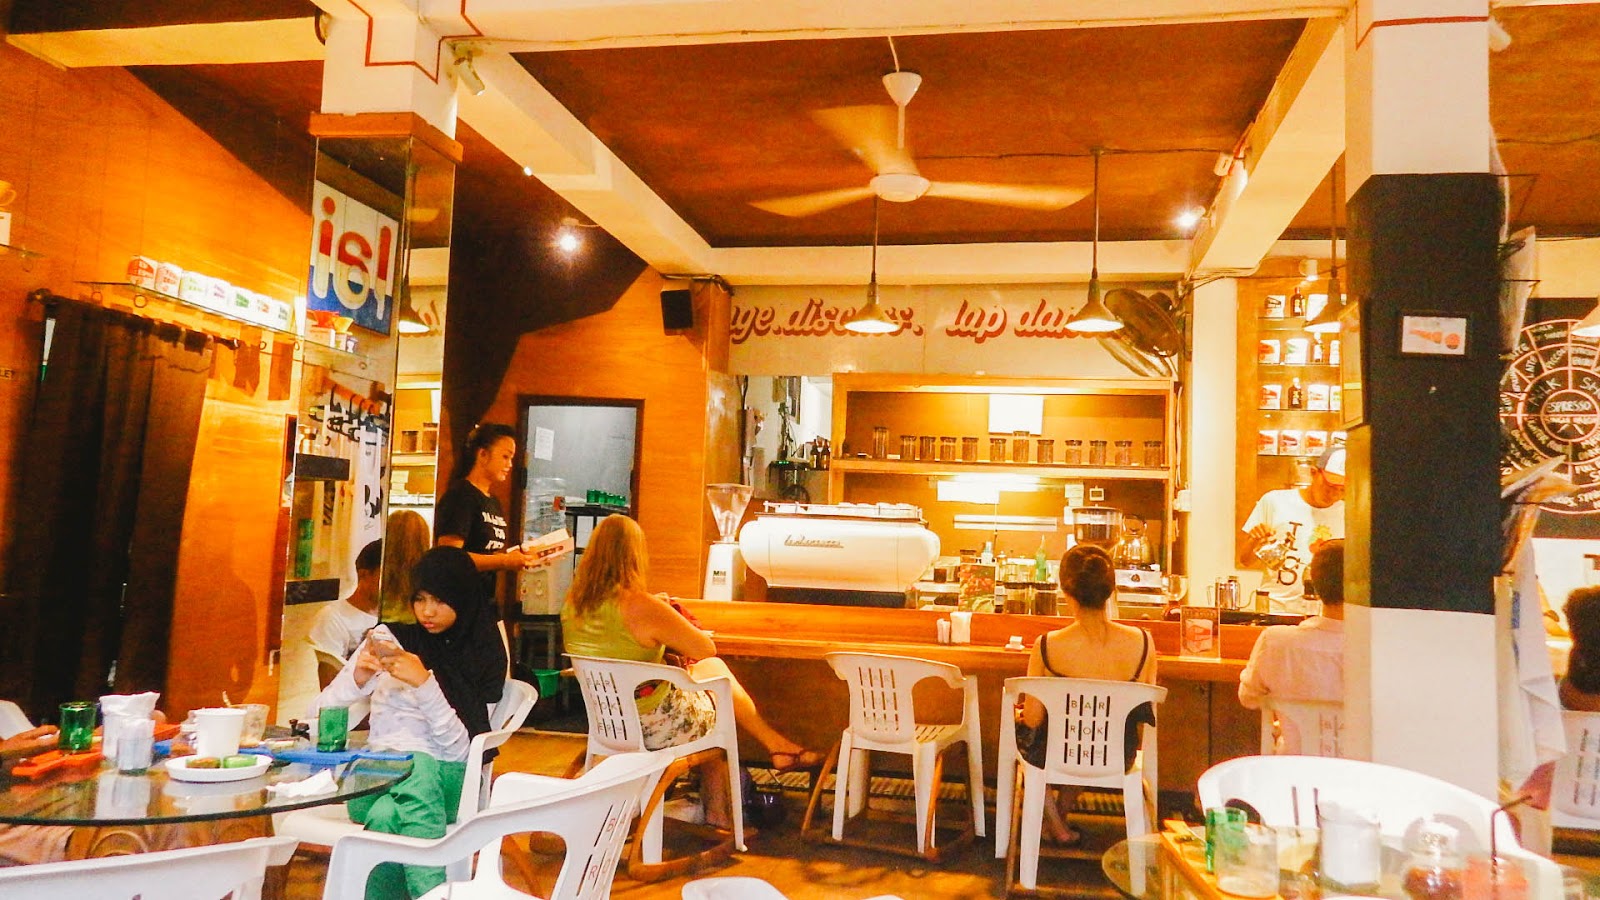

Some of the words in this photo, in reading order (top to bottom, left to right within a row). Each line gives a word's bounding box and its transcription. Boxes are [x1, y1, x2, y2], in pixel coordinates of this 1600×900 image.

[946, 299, 1007, 344] lap
[1071, 699, 1105, 711] BAR
[1069, 723, 1104, 736] ROK
[1068, 748, 1090, 758] ER
